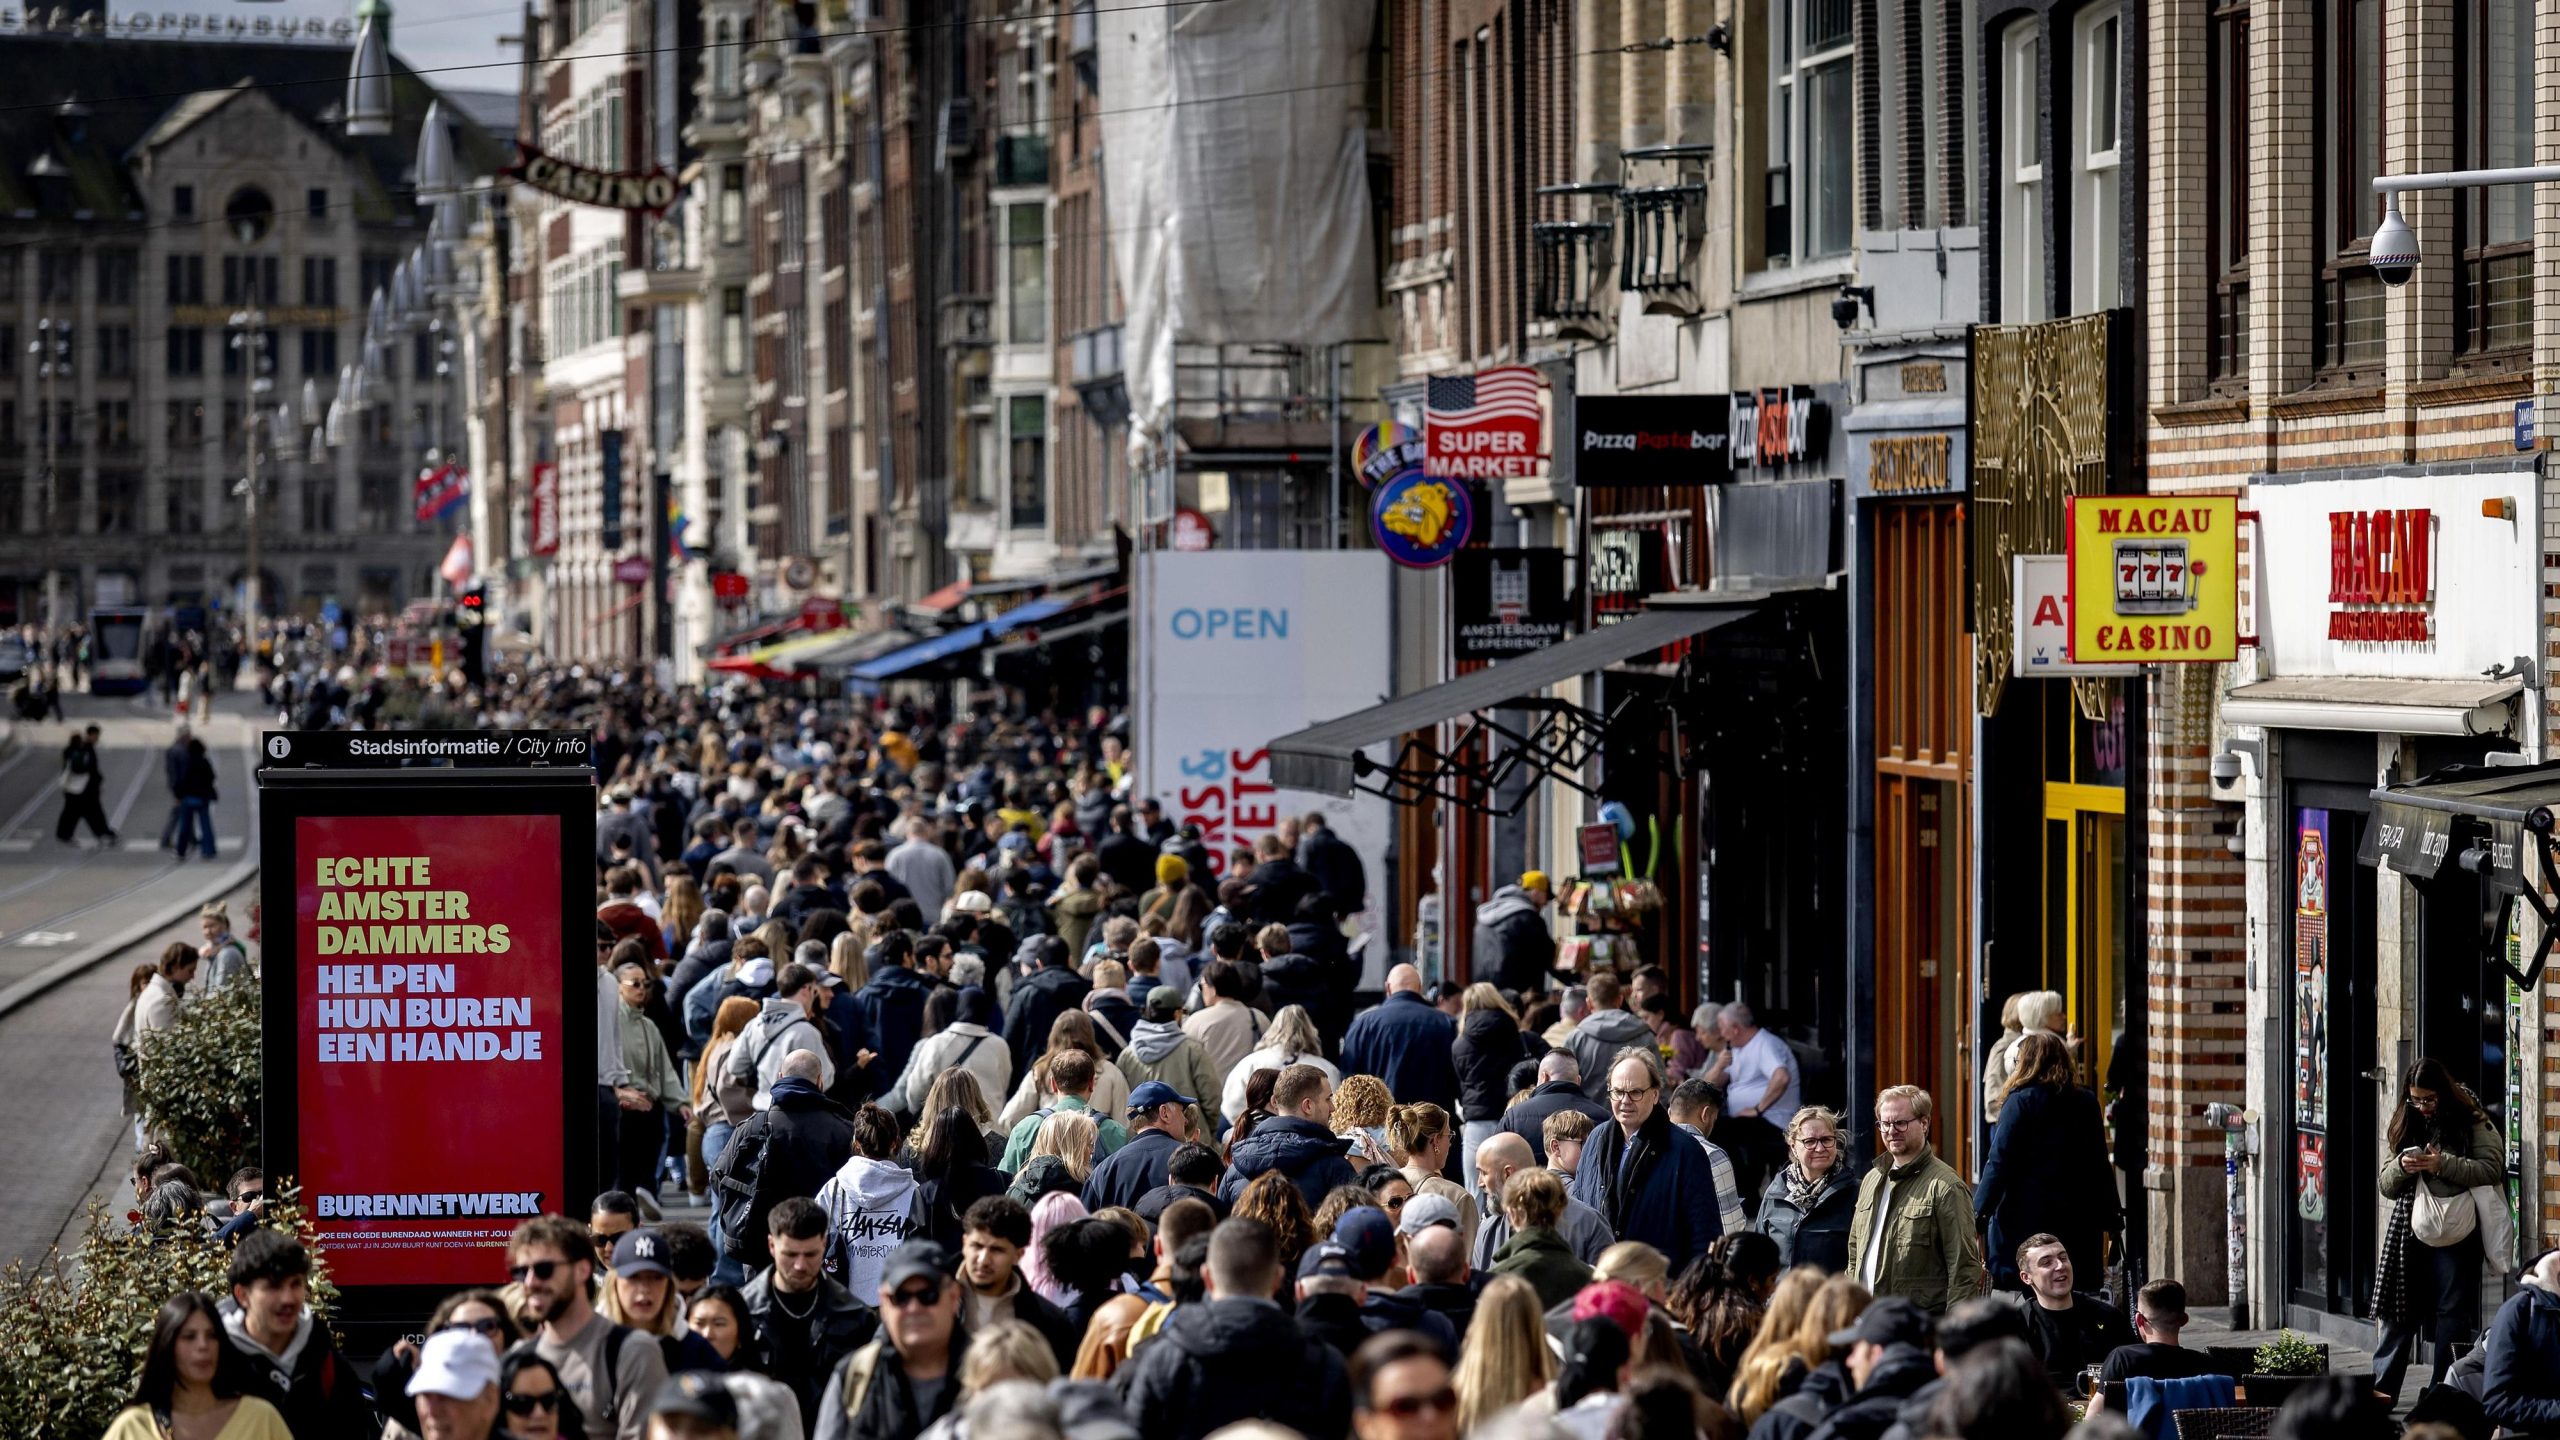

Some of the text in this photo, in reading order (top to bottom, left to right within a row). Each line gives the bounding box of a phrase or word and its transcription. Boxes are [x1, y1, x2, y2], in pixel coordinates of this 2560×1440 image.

[526, 156, 674, 207] CASINO
[1439, 431, 1526, 454] SUPER
[1429, 456, 1537, 478] MARKET
[2098, 509, 2212, 534] MACAU
[2328, 508, 2431, 603] MACAU
[2120, 564, 2184, 582] 7 7 7
[1171, 608, 1289, 639] OPEN
[1461, 624, 1560, 636] AMSTERDAM
[349, 738, 586, 757] Stadsinformatie / City info
[317, 857, 431, 887] ECHTE
[317, 891, 470, 921] AMSTER
[318, 924, 511, 955] DAMMERS
[318, 964, 455, 994] HELPEN
[318, 997, 531, 1028] HUN BUREN
[318, 1031, 542, 1062] EEN HANDJE
[317, 1193, 540, 1217] BURENNETWERK
